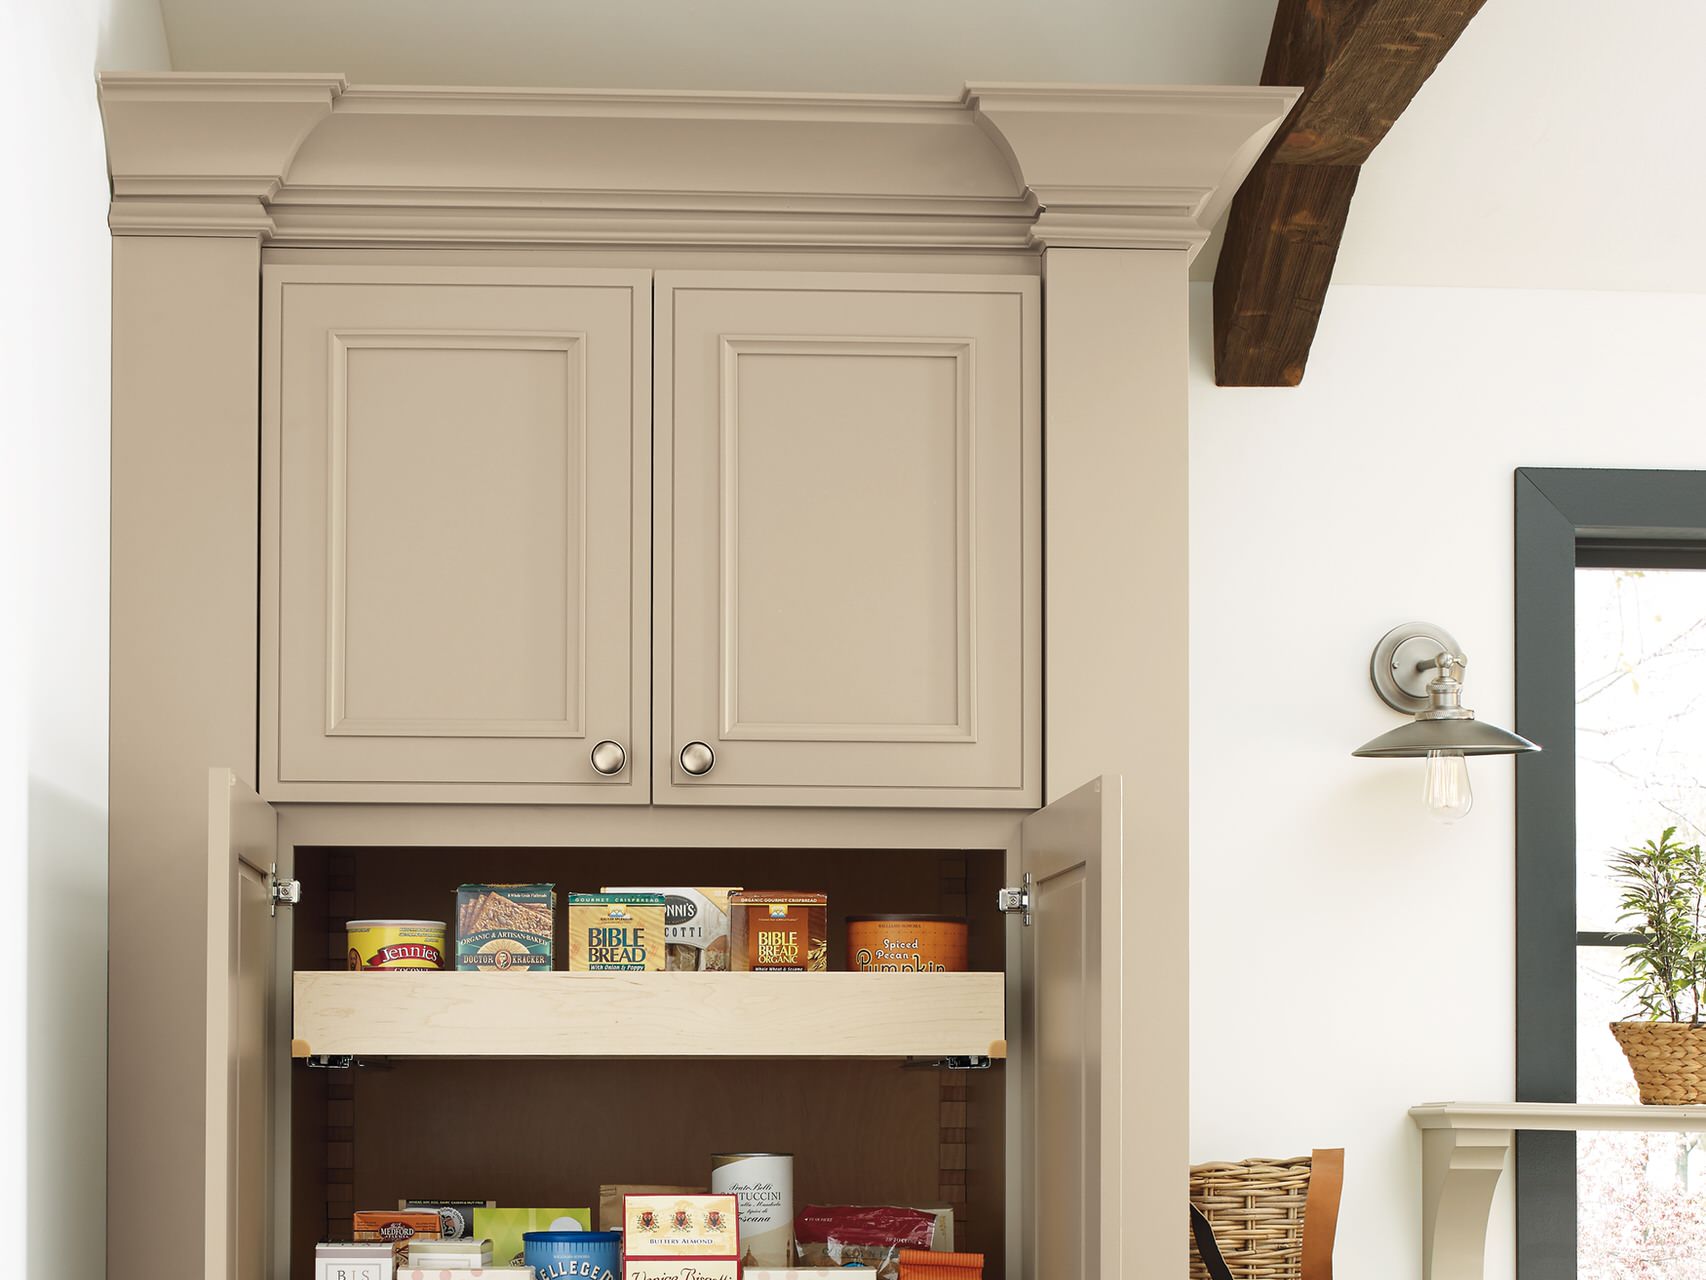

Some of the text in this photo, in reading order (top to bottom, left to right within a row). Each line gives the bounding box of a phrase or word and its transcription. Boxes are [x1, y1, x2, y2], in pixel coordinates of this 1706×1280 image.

[665, 903, 695, 916] NNI'S
[460, 932, 490, 945] ORGANIC
[588, 928, 644, 947] BIBLE
[758, 931, 797, 945] BIBLE
[883, 938, 918, 950] Spiced
[382, 945, 438, 962] Jennies
[588, 948, 646, 962] BREAD
[758, 945, 799, 956] BREAD
[875, 950, 909, 959] Pecan
[463, 955, 545, 963] DOCTOR KRACKER
[720, 1192, 781, 1200] TUCCINI
[380, 1227, 414, 1236] MEDFORD
